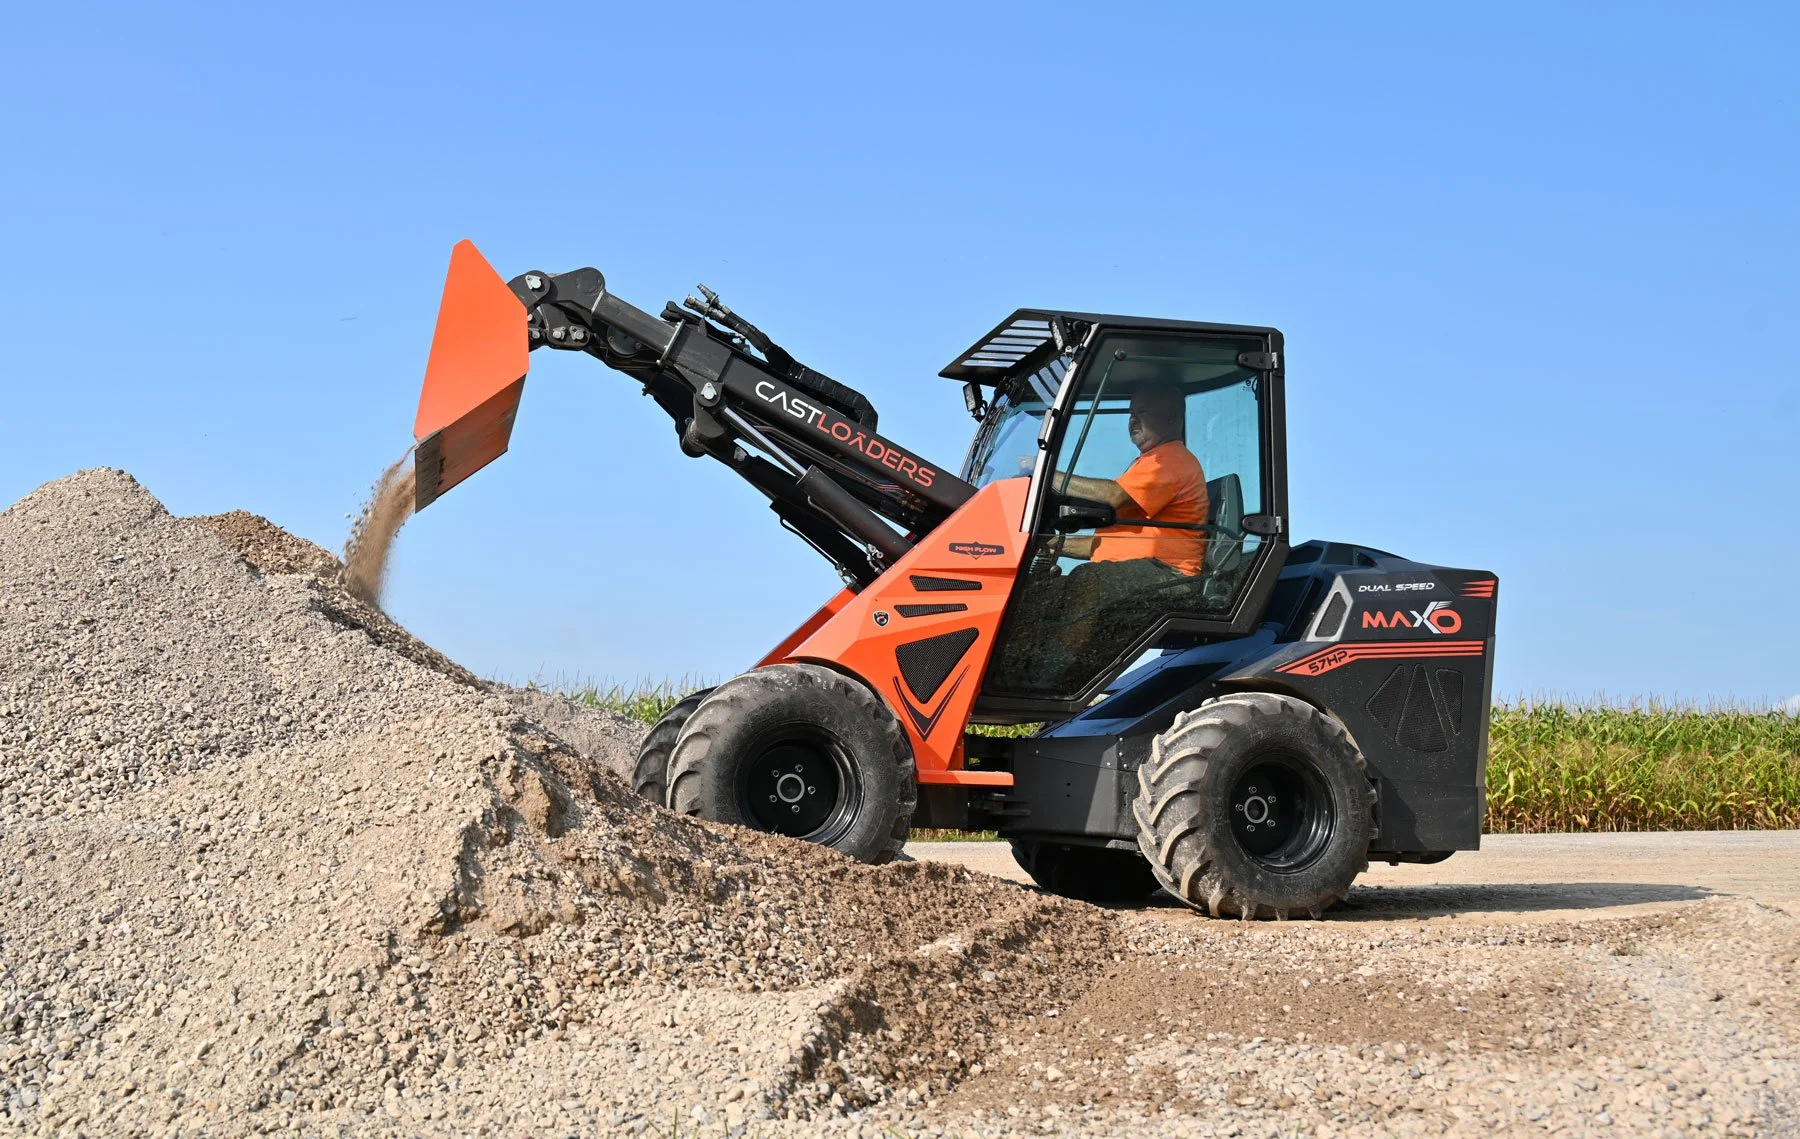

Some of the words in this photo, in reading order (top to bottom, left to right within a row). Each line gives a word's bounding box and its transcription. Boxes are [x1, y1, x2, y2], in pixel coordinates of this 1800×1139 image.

[1358, 584, 1392, 593] DUAL
[1395, 582, 1435, 592] SPEED
[1308, 650, 1348, 674] 57HP
